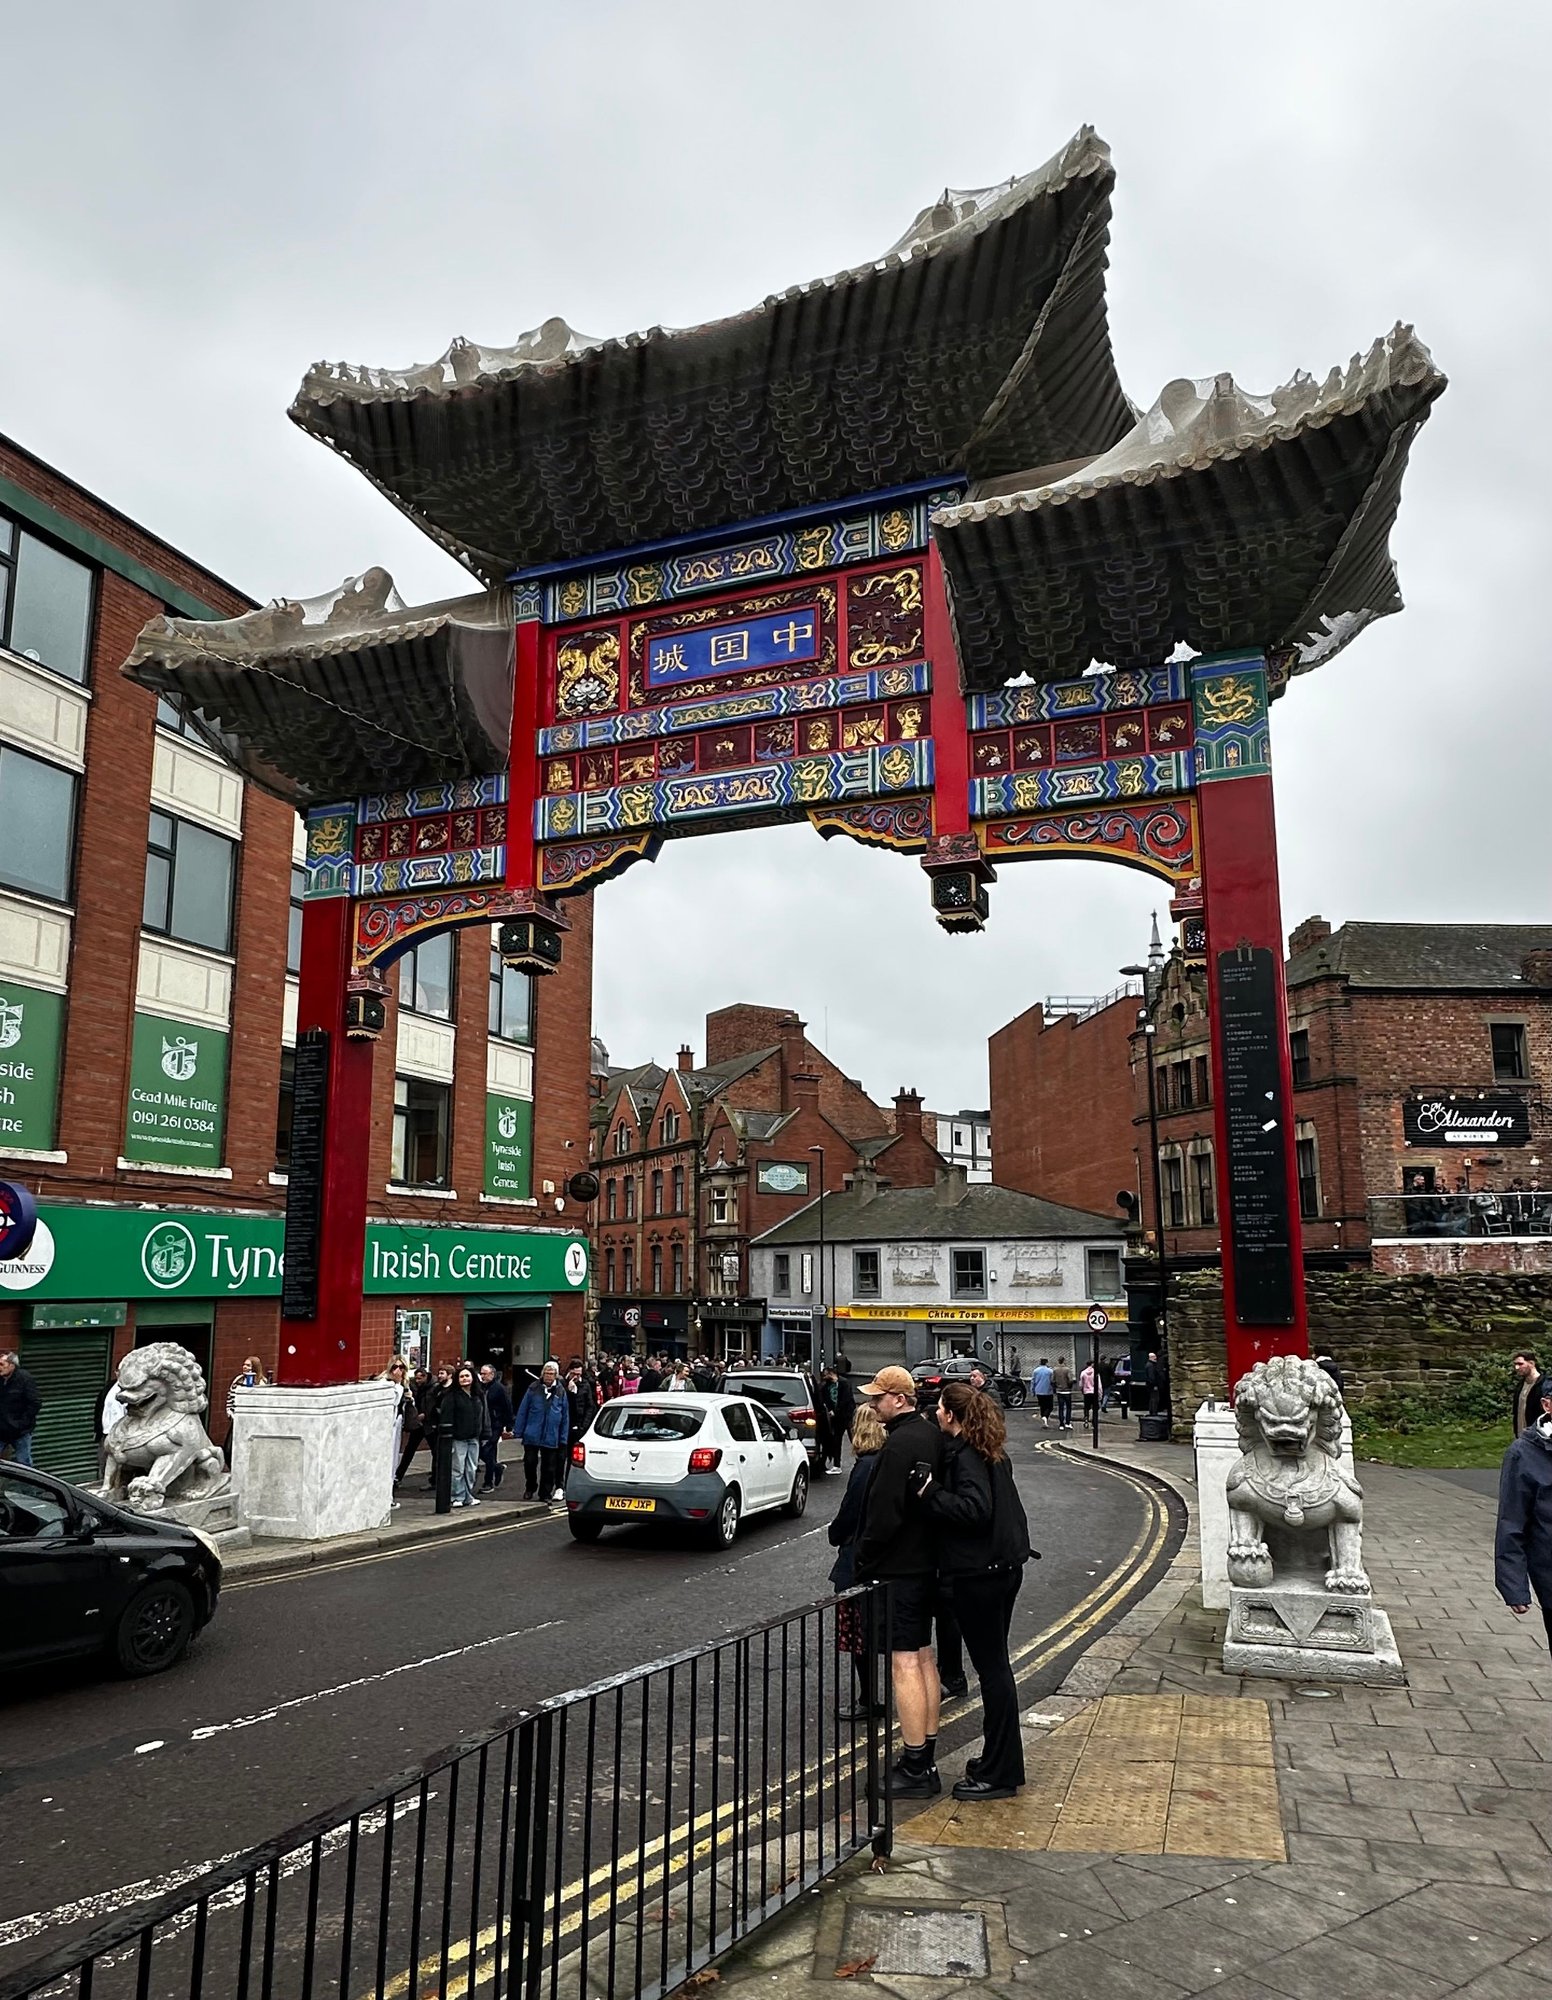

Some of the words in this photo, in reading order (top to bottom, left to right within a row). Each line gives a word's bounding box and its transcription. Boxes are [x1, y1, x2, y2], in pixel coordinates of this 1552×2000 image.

[131, 1088, 162, 1104] Cead
[164, 1092, 188, 1108] Mile
[132, 1110, 158, 1125] 0191
[160, 1114, 181, 1129] 261
[183, 1118, 215, 1133] 0384
[1417, 1104, 1515, 1132] Alexanders
[491, 1141, 522, 1157] Tyneside
[497, 1159, 516, 1172] Irish
[371, 1241, 441, 1279] Irish
[448, 1244, 532, 1279] Centre
[626, 1312, 640, 1321] 20
[927, 1309, 956, 1319] China
[959, 1310, 986, 1319] Town
[993, 1310, 1036, 1319] EXPRESS
[1090, 1314, 1106, 1325] 20
[609, 1498, 633, 1508] NX67
[634, 1499, 652, 1510] JXP
